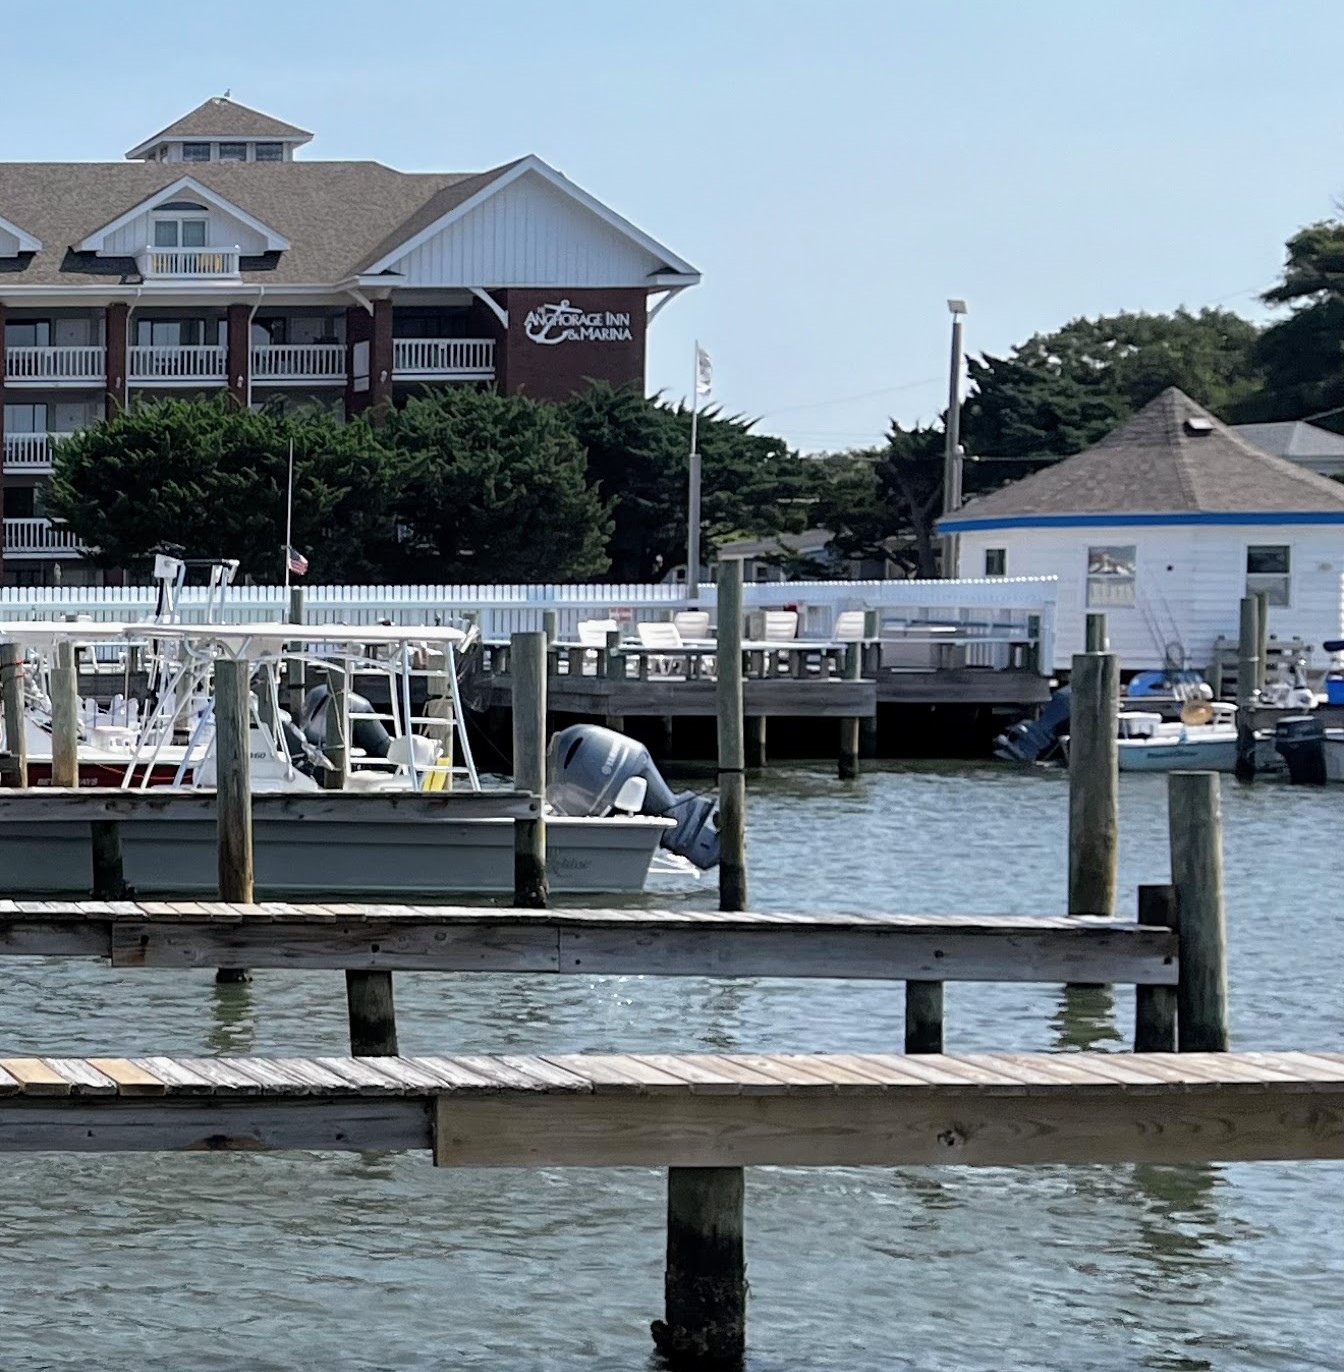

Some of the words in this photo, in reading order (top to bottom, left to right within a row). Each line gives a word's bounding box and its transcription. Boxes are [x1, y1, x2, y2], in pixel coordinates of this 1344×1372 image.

[524, 311, 603, 326] ANCHORAGE
[605, 311, 630, 326] INN
[567, 328, 580, 340] &
[580, 327, 632, 340] MARINA
